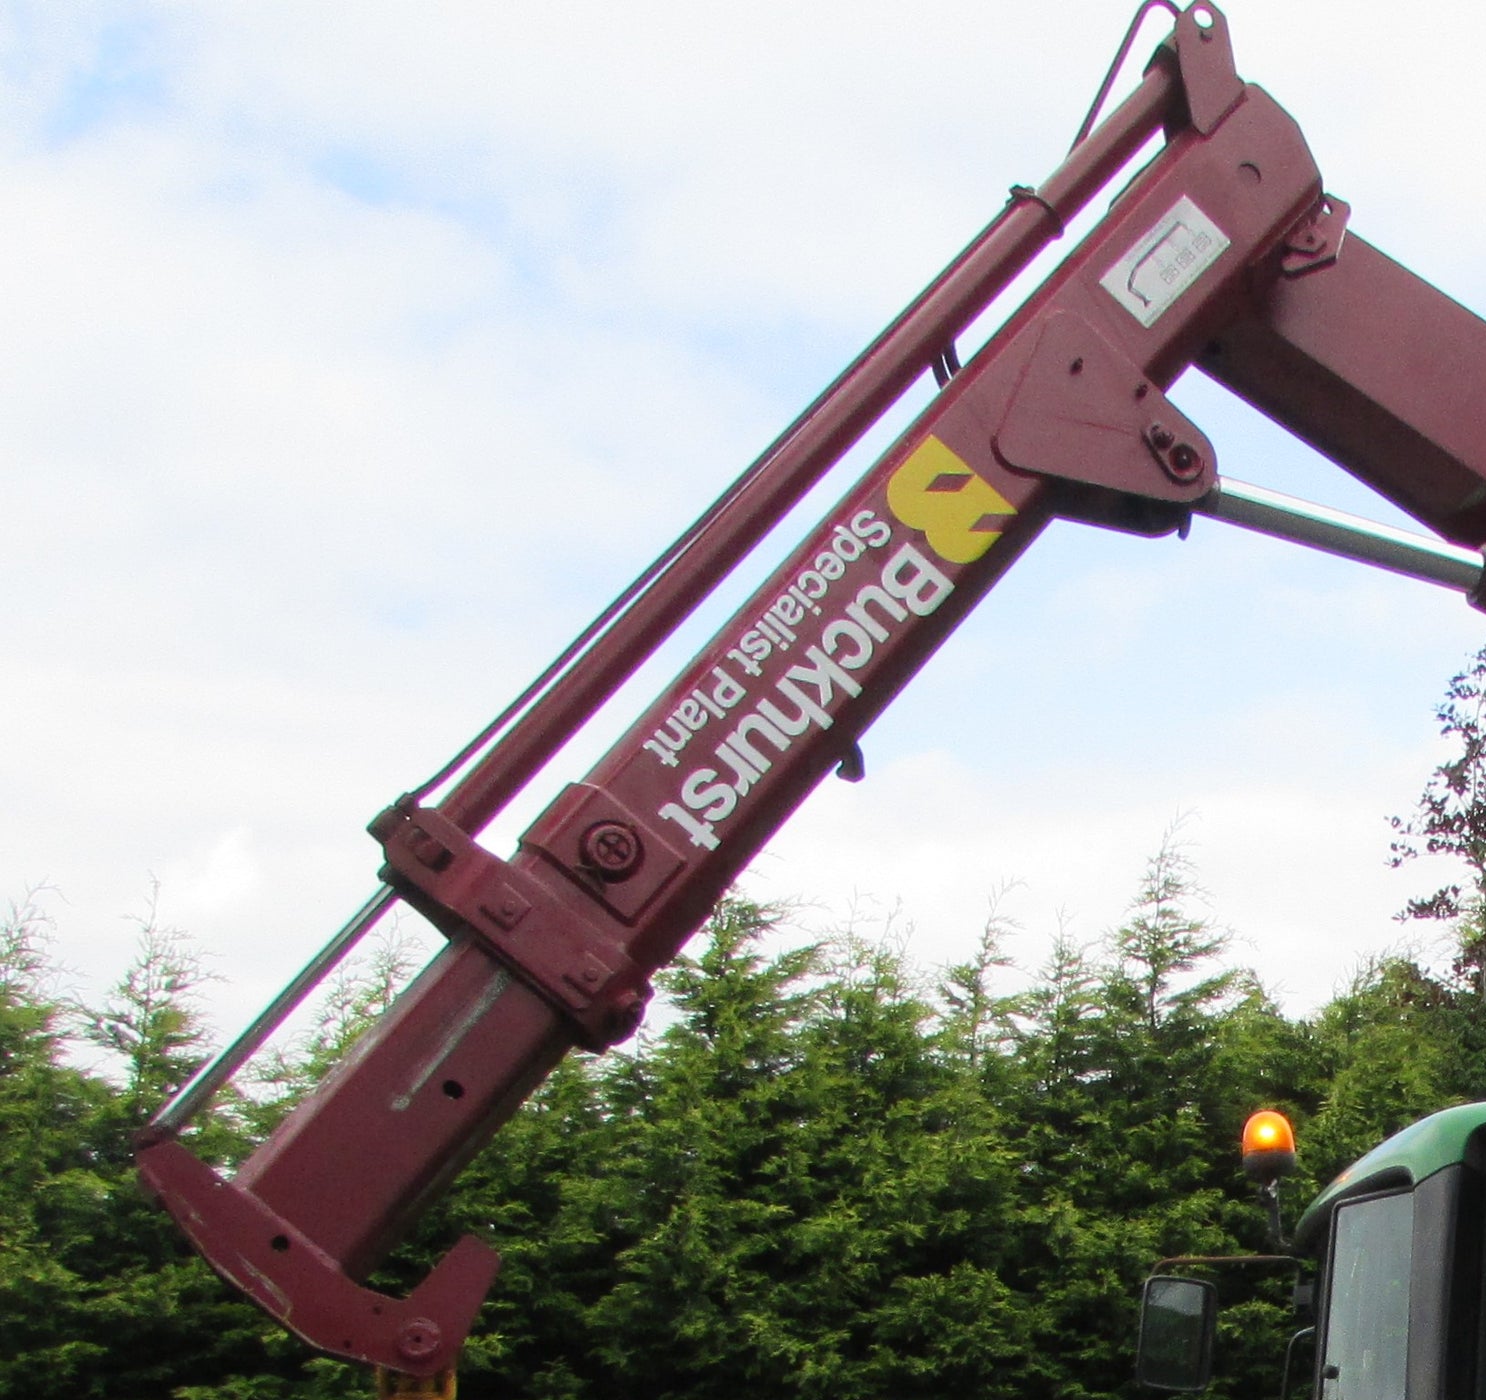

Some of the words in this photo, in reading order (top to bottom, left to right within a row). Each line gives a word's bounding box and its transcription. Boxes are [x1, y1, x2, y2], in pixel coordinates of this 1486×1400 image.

[727, 509, 891, 677] Specialist
[643, 666, 746, 767] Plant
[658, 542, 955, 851] Buckhurst
